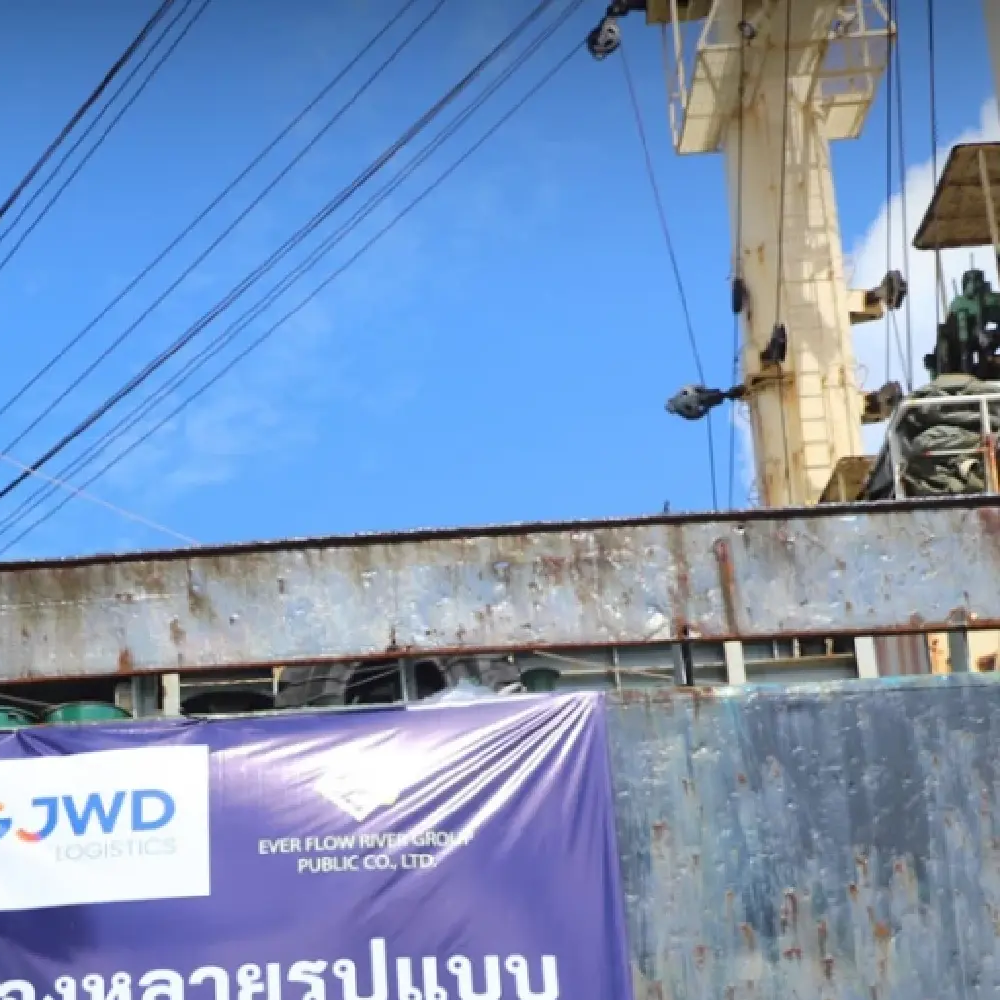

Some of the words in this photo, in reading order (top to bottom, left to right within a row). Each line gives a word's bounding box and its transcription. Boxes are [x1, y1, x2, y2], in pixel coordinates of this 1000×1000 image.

[55, 837, 178, 862] LOGISTICS
[258, 838, 302, 855] EVER
[305, 835, 355, 851] FLOW
[297, 855, 359, 873] PUBLIC
[363, 853, 397, 871] CO.,
